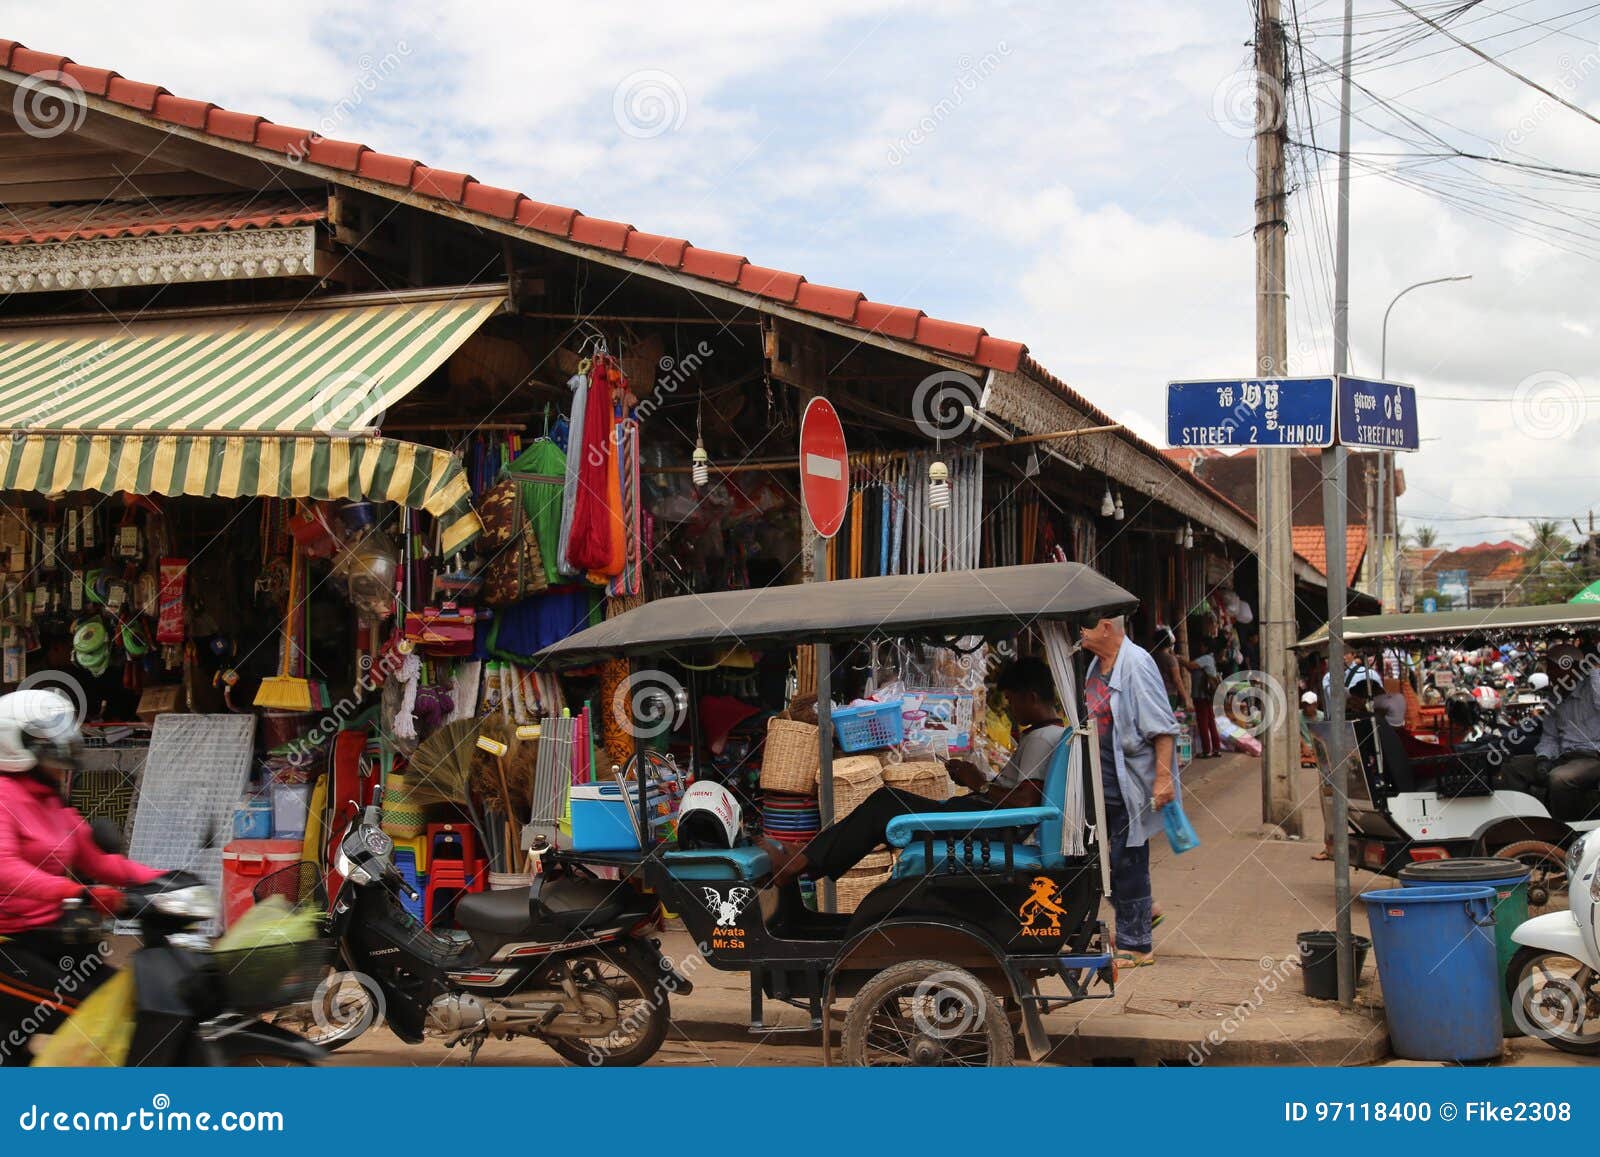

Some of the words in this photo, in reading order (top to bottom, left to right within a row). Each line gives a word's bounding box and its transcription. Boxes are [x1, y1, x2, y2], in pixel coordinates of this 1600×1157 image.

[1183, 426, 1233, 444] STREET
[1250, 425, 1257, 442] 2
[1279, 424, 1323, 442] THNOU
[1358, 425, 1385, 444] STREET
[713, 927, 745, 936] Avata
[1022, 926, 1060, 936] Avata
[713, 938, 745, 948] Mr.Sa
